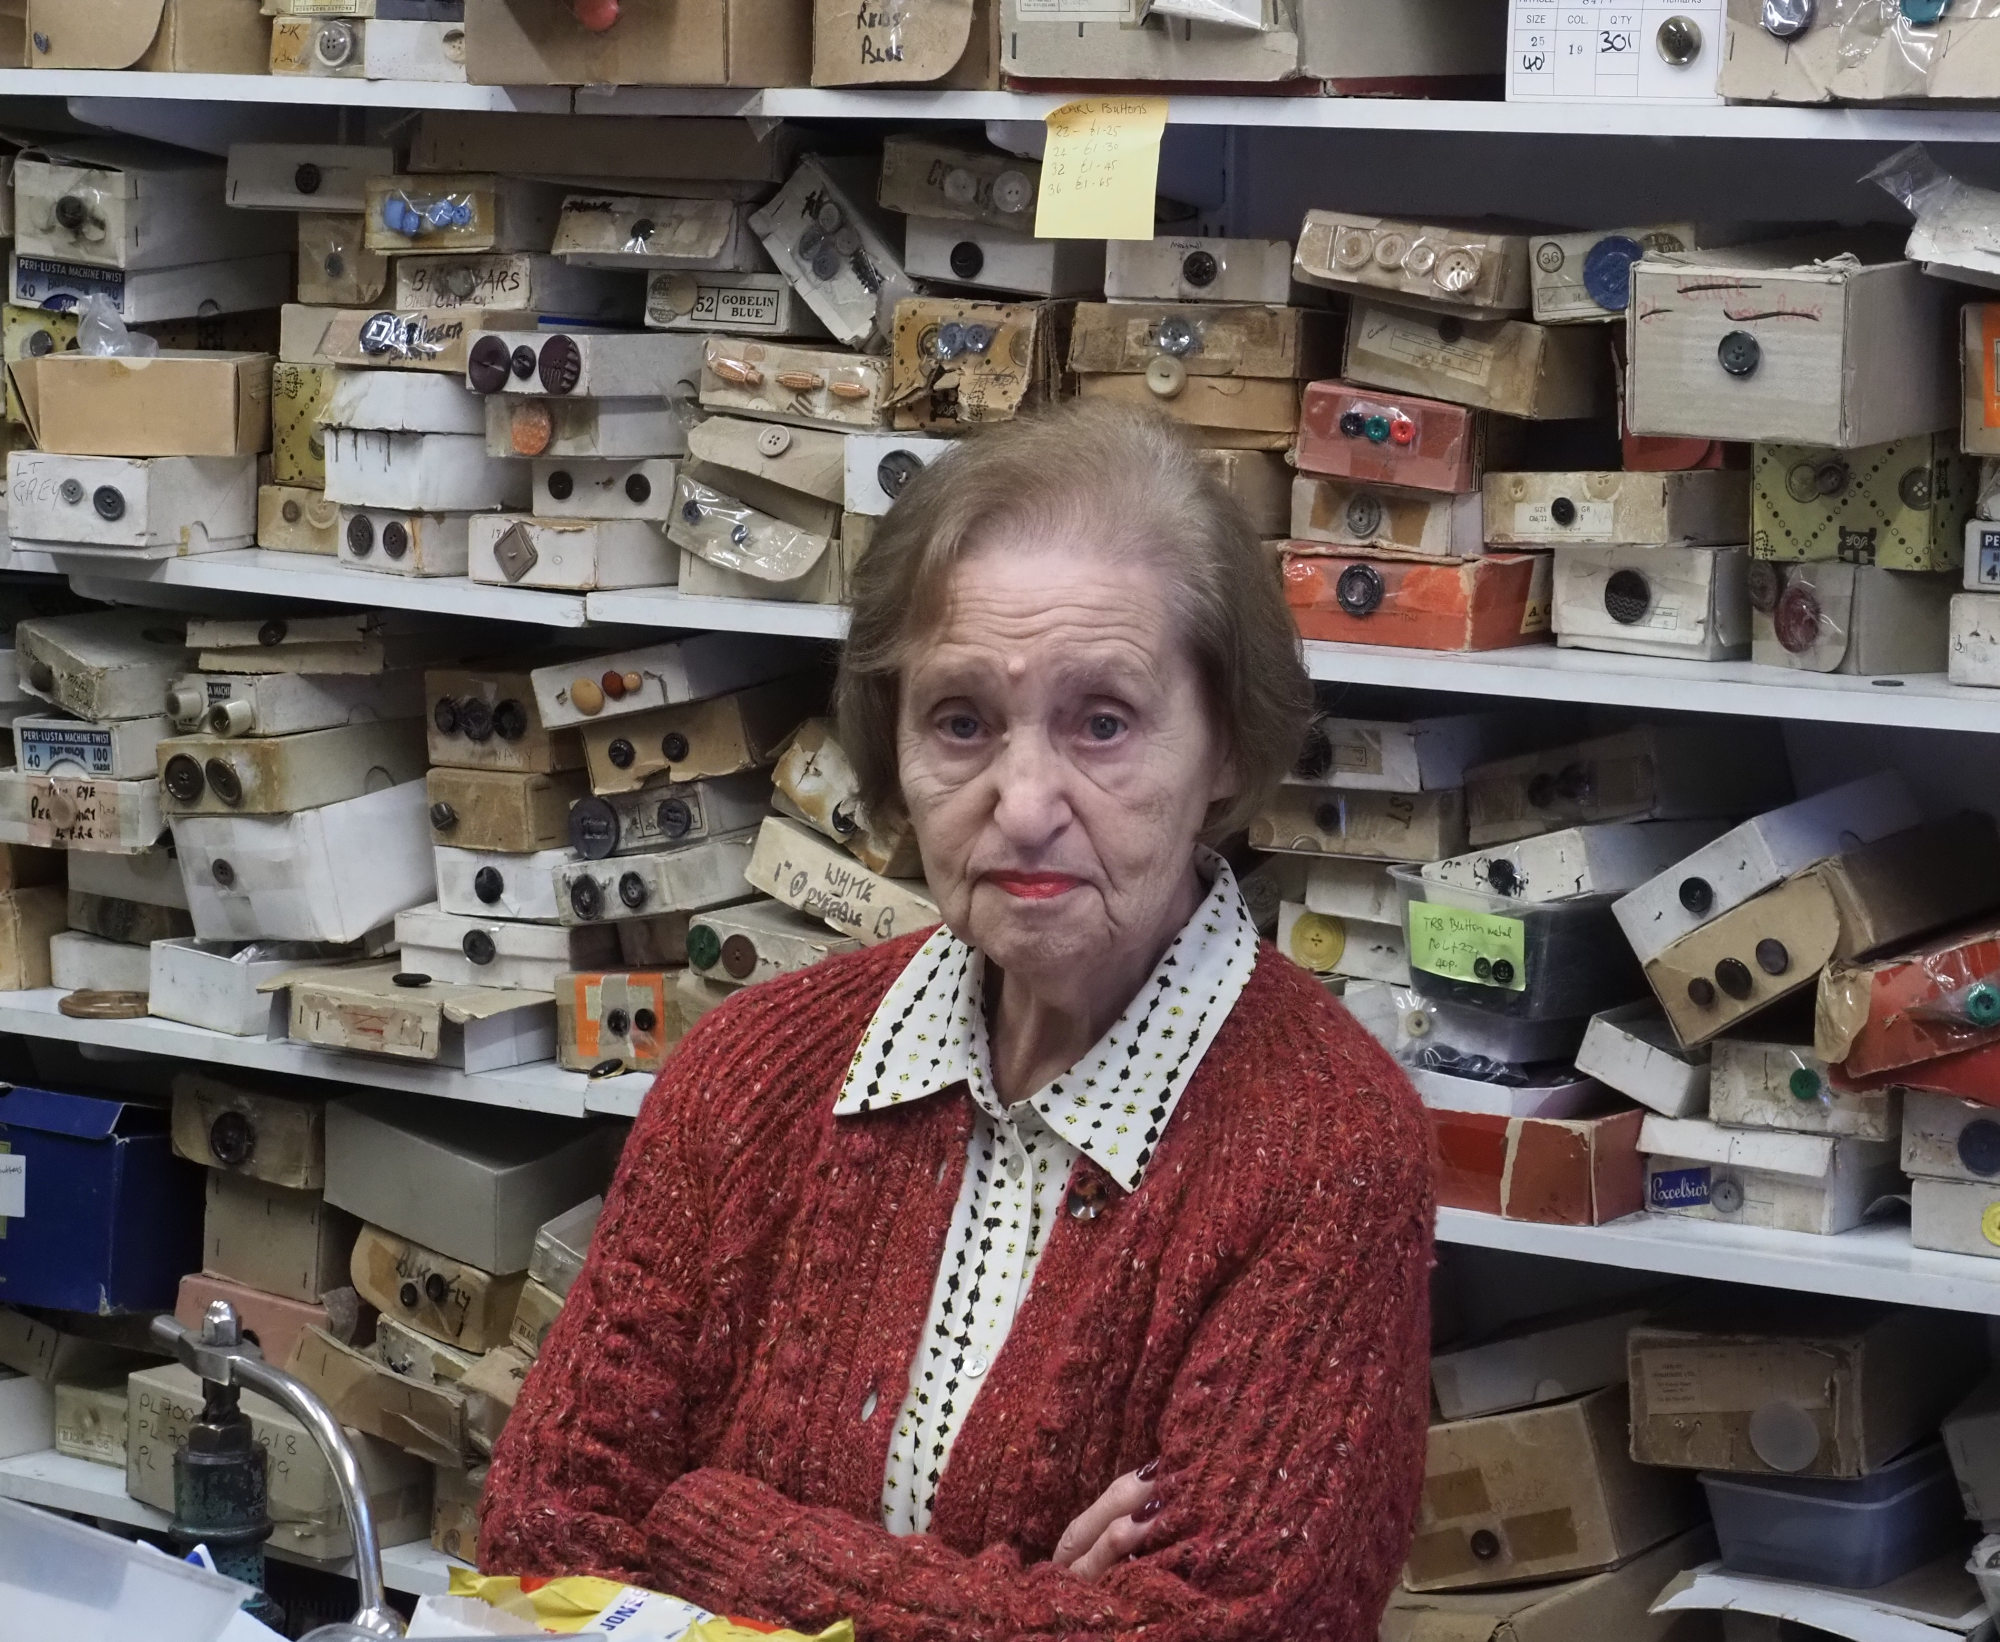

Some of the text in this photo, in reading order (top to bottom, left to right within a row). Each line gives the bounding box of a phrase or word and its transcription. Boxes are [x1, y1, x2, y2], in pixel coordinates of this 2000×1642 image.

[1526, 15, 1546, 24] SIZE
[1567, 16, 1588, 25] COL.
[1531, 36, 1545, 47] 25
[1600, 31, 1631, 53] 301
[1569, 45, 1583, 55] 19
[1541, 252, 1560, 265] 36
[20, 259, 122, 284] PERI-LUSTA MACHINE TWIST
[21, 283, 36, 298] 40
[695, 296, 714, 312] 52
[722, 295, 774, 307] GOBELIN
[731, 307, 764, 318] BLUE
[17, 461, 44, 476] LT
[14, 477, 61, 511] GREY
[23, 730, 110, 744] PERI-LUSTA MACHINE TWIST
[27, 754, 41, 768] 40
[93, 747, 108, 762] 100
[77, 785, 96, 801] EYE
[824, 862, 876, 903] WHITE
[1653, 1176, 1710, 1201] Excelsior
